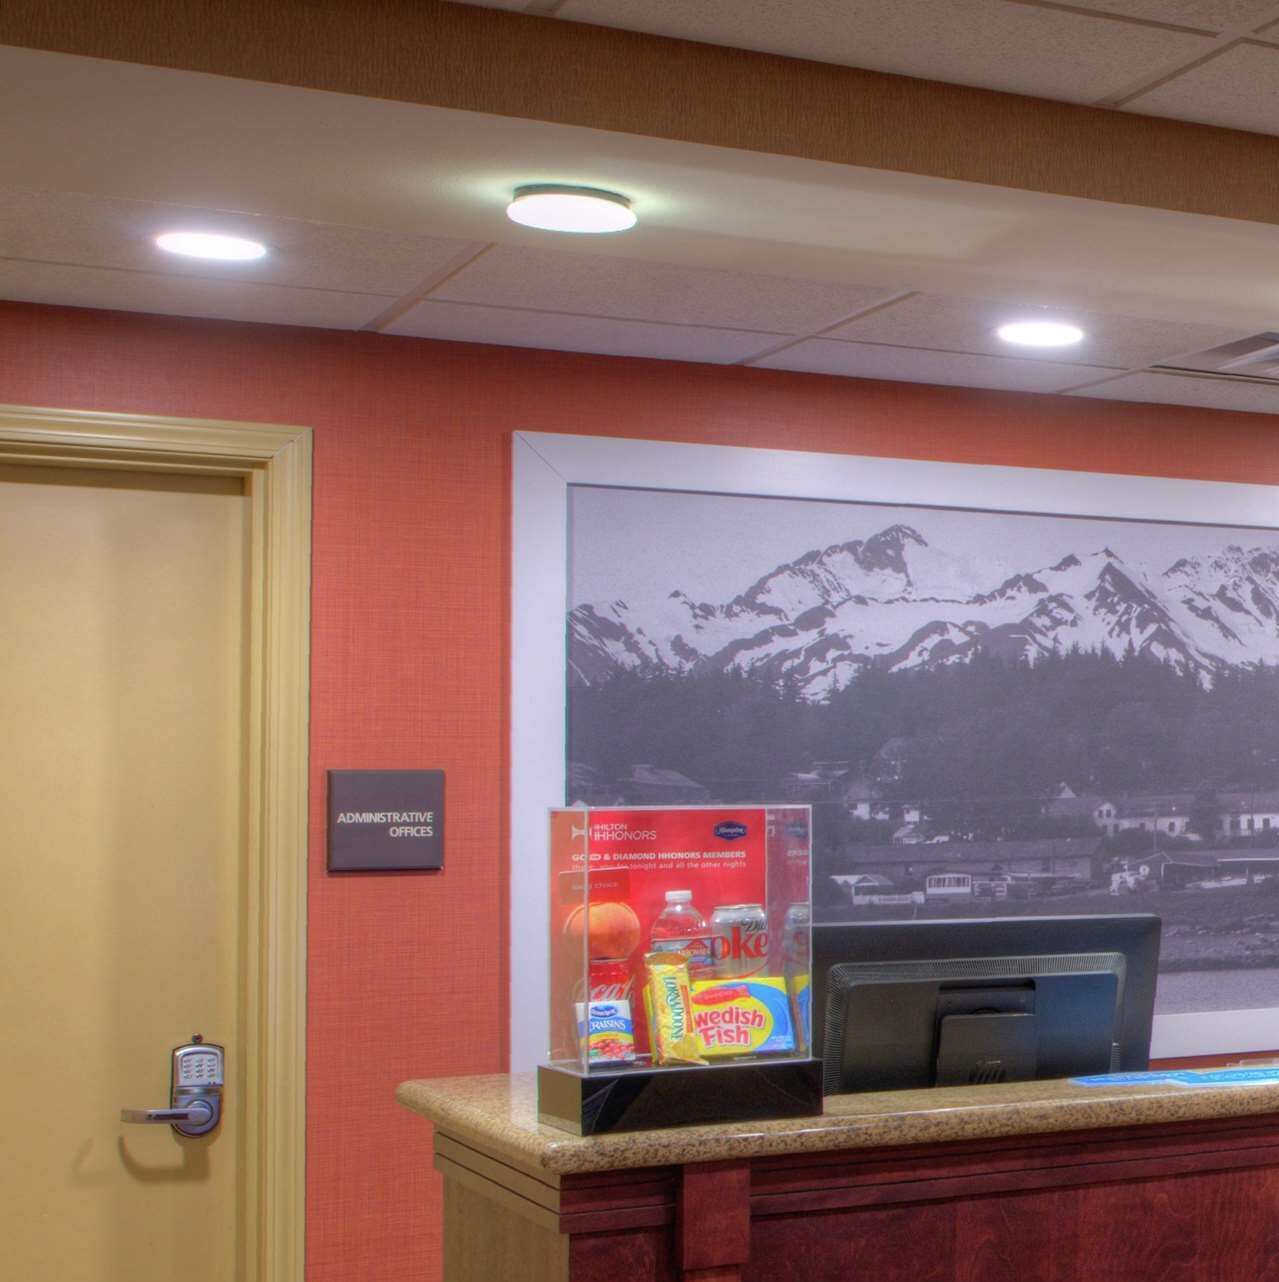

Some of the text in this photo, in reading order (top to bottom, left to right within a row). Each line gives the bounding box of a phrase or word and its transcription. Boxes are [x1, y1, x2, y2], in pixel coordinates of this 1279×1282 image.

[337, 812, 433, 823] ADMINISTRATIVE
[389, 826, 433, 837] OFFICES
[603, 853, 612, 861] &
[613, 852, 657, 861] DIAMOND
[658, 851, 701, 859] HHONORS
[702, 850, 747, 859] MEMBERS
[694, 1005, 765, 1029] wedish
[698, 1022, 752, 1048] Fish
